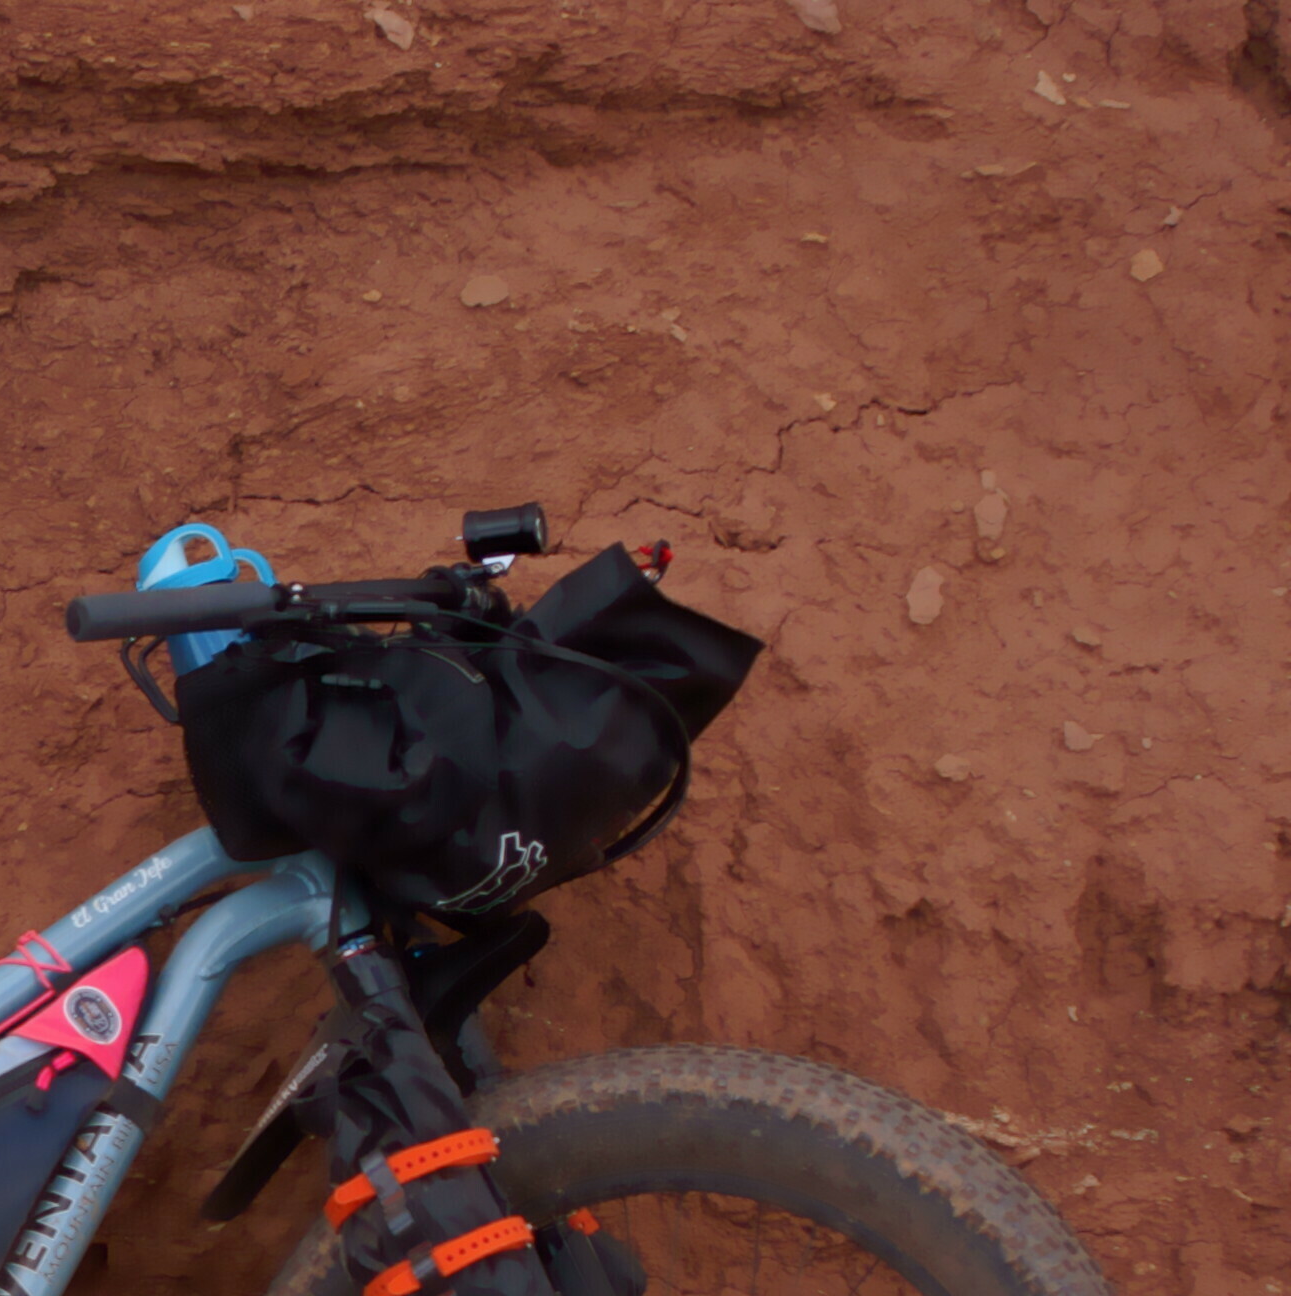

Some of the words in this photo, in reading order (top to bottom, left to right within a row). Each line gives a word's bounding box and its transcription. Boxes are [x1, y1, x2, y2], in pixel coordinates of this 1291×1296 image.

[70, 905, 92, 928] El
[92, 882, 137, 914] Gran
[133, 857, 173, 889] Jefe
[41, 1154, 116, 1287] MOUNTAIN
[145, 1041, 180, 1086] USA
